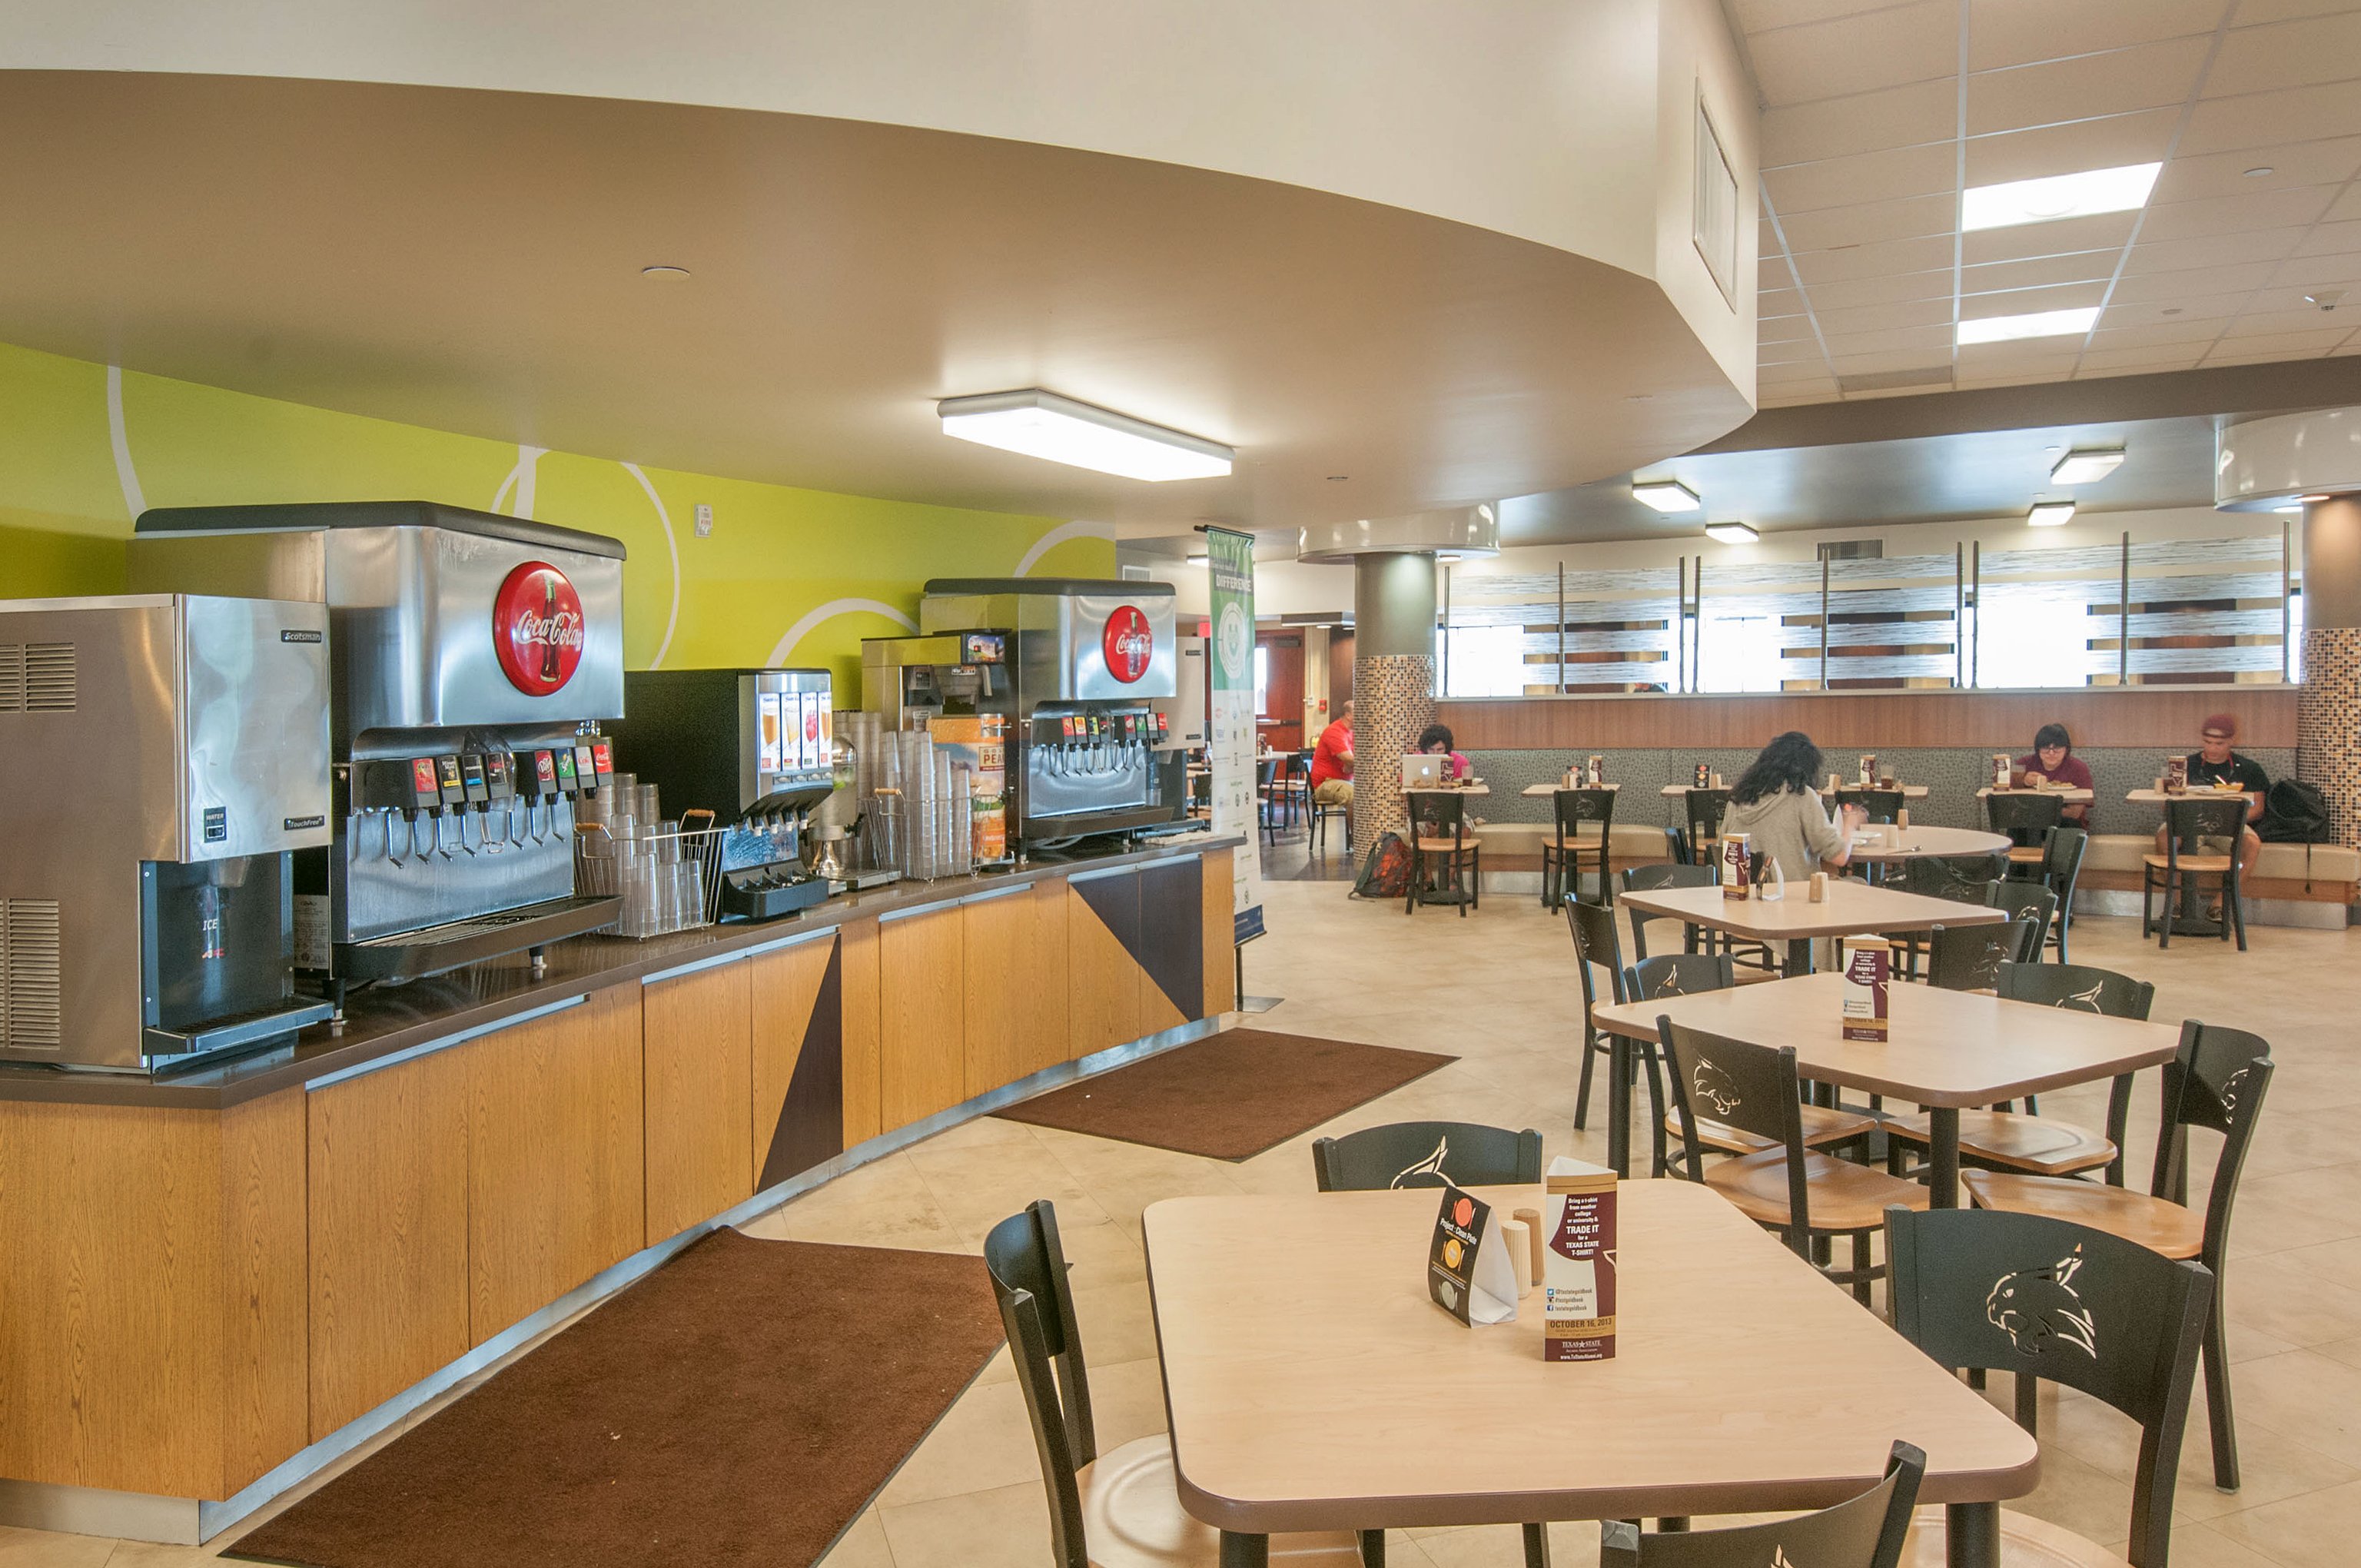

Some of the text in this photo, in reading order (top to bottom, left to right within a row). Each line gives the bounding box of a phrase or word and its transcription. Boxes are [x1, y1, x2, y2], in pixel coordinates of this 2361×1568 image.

[516, 610, 582, 652] Coca-Cola
[285, 632, 320, 641] Scotsman
[290, 819, 320, 828] TouchFree
[202, 919, 218, 932] ICE
[1566, 1224, 1599, 1234] TRADE IT
[1550, 1320, 1585, 1328] OCTOBER
[1597, 1317, 1612, 1327] 2013
